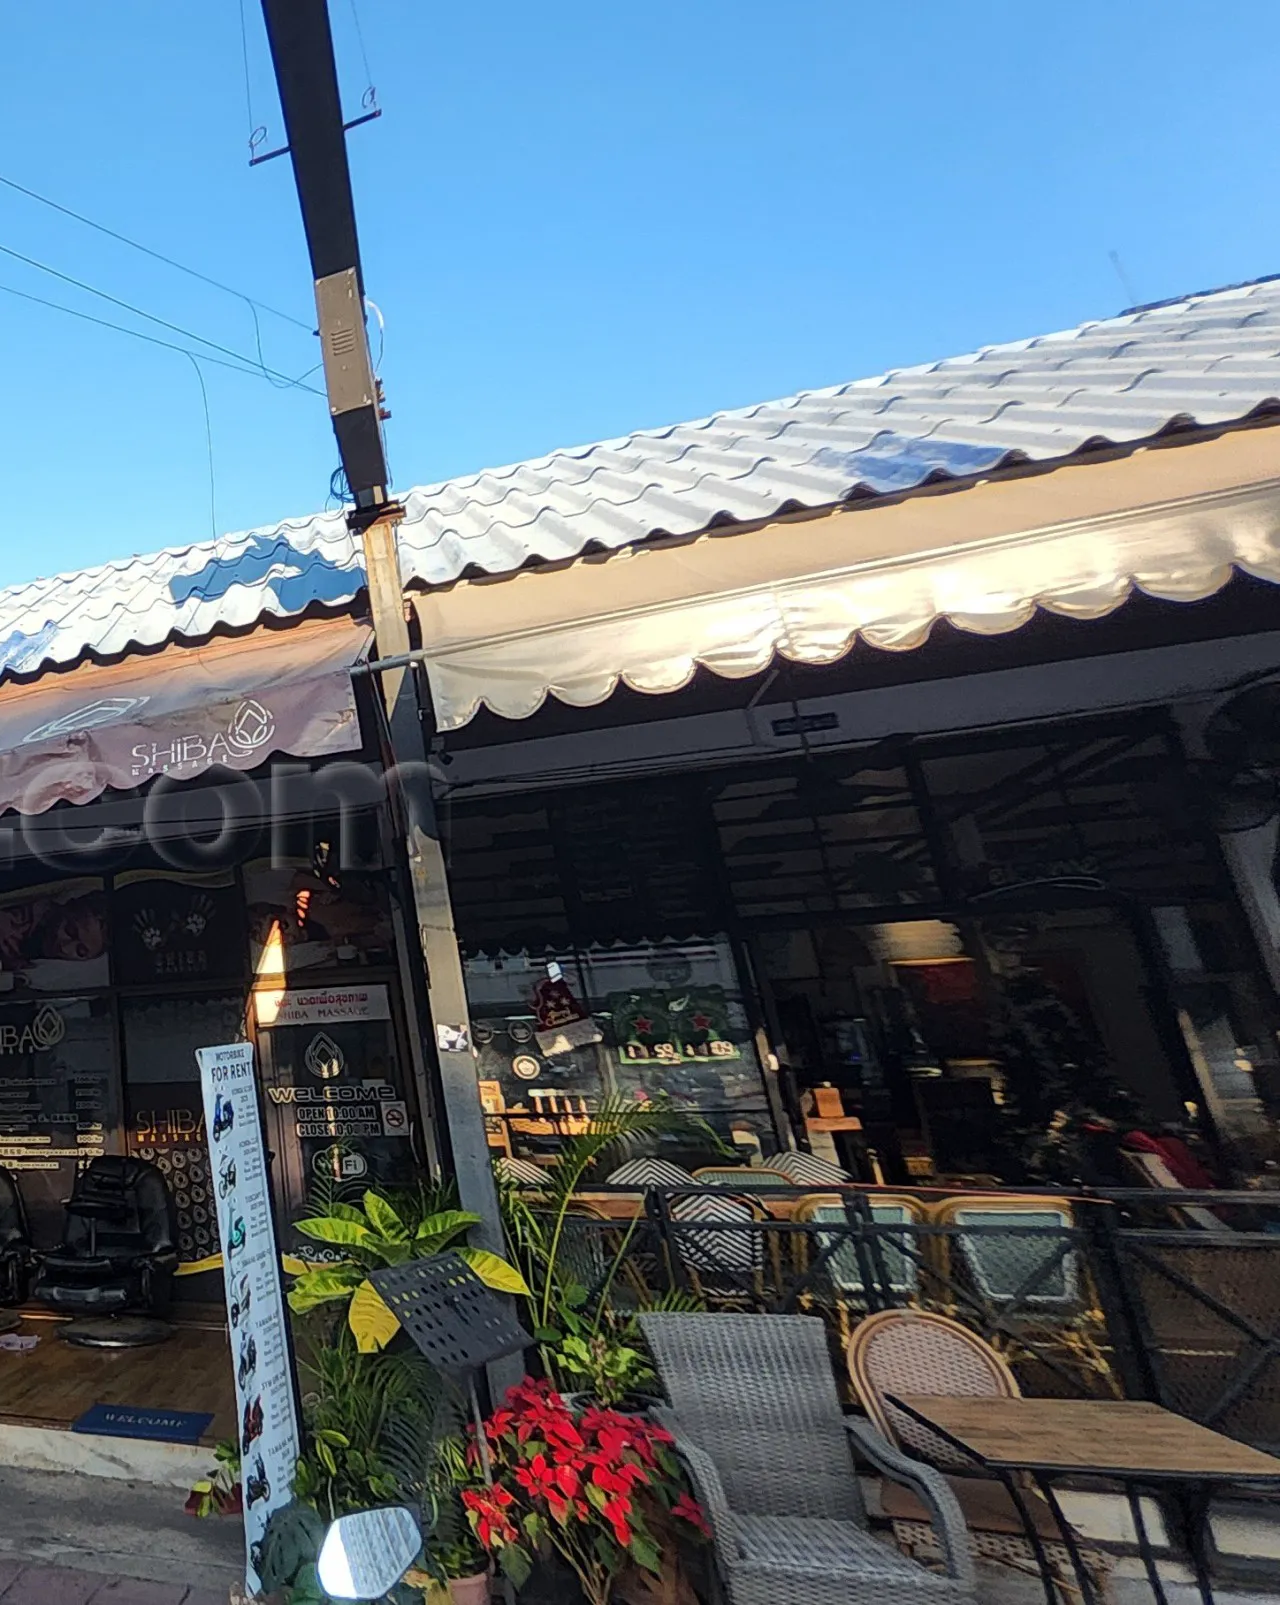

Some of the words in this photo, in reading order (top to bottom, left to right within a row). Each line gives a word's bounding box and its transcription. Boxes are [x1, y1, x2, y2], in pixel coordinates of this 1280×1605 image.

[132, 732, 234, 768] SHIBA
[131, 755, 228, 776] MASSAGE
[211, 1065, 228, 1083] FOR
[230, 1061, 251, 1080] RENT
[299, 1108, 324, 1119] OPEN
[358, 1107, 375, 1119] AM
[299, 1123, 328, 1136] CLOSE
